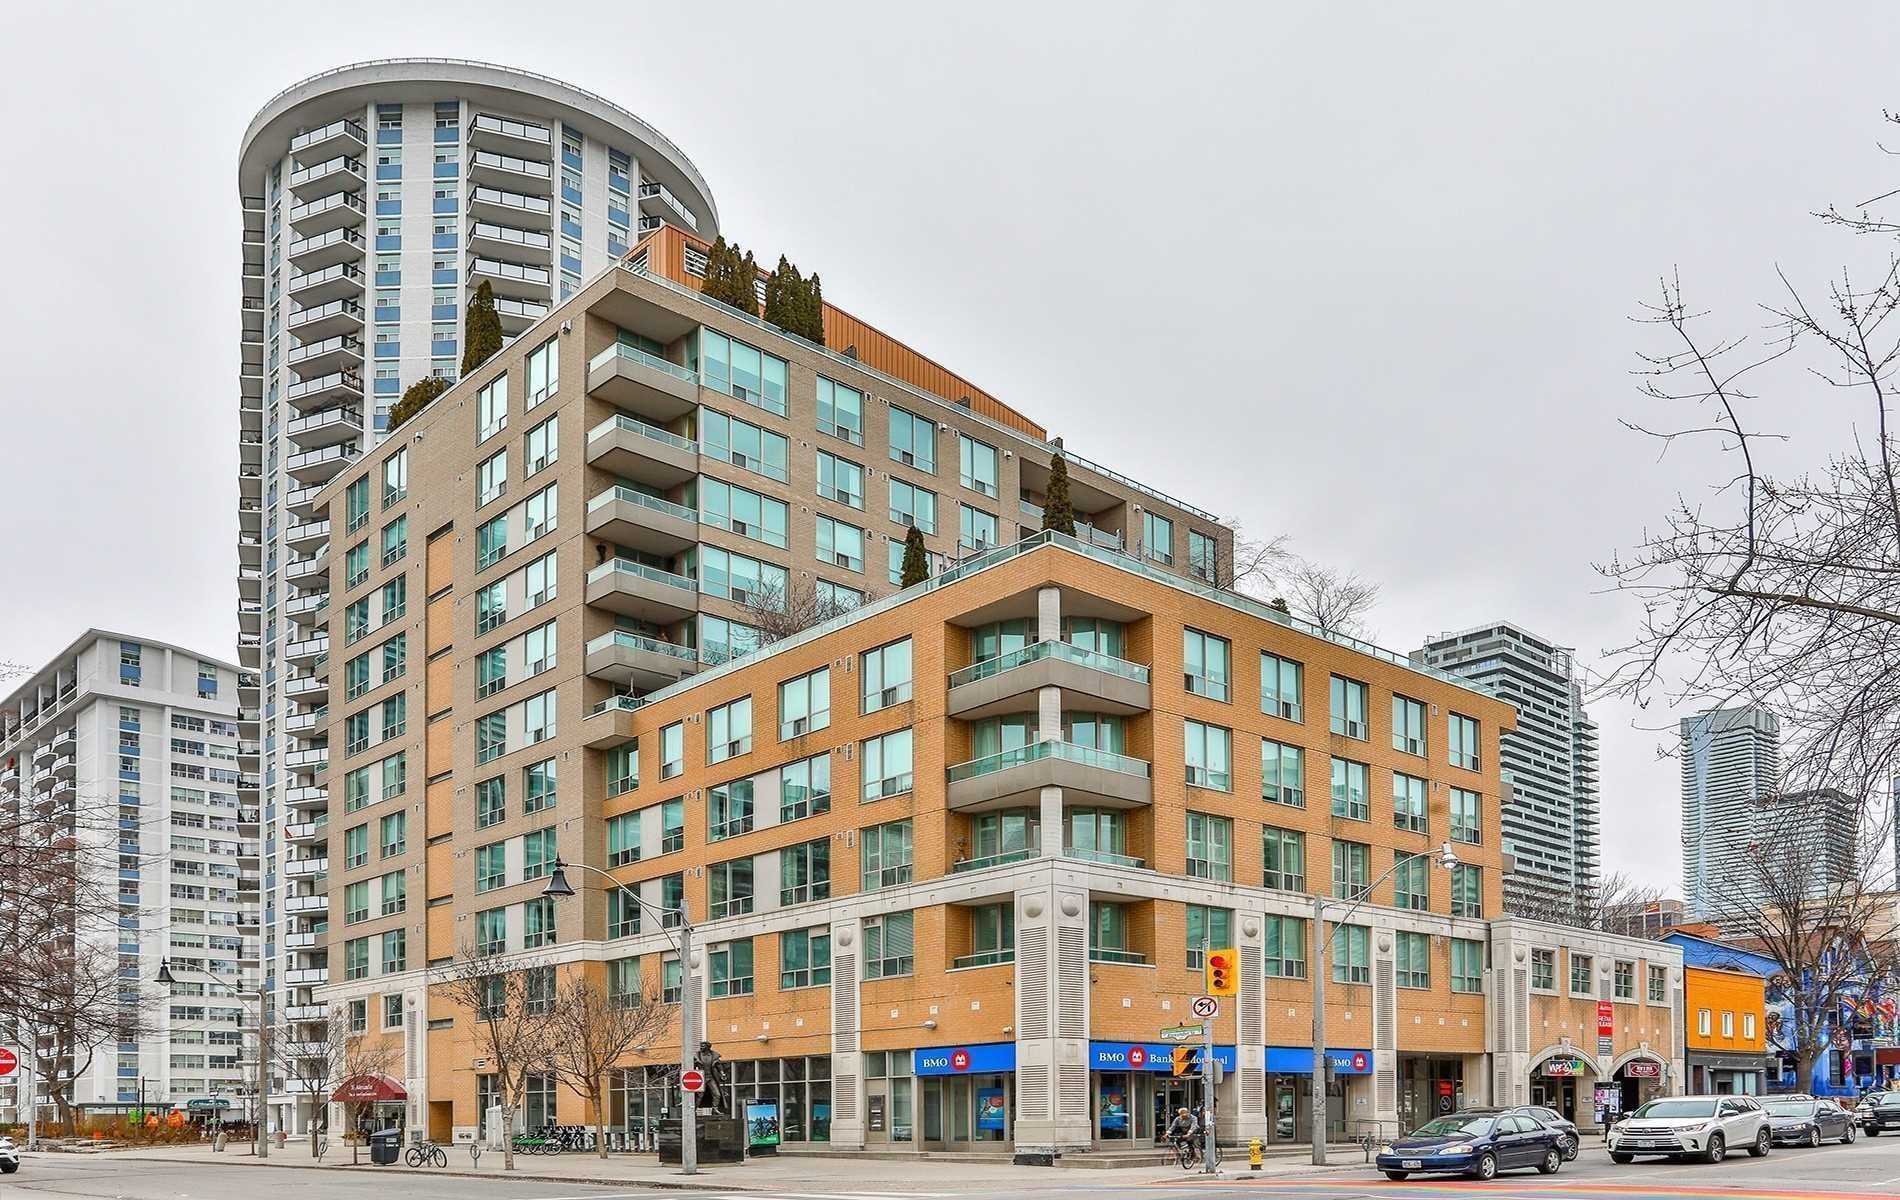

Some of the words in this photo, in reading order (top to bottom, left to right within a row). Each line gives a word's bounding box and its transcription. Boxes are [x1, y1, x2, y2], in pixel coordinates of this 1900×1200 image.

[923, 1057, 948, 1068] BMO
[1099, 1052, 1125, 1063] BMO
[1150, 1053, 1175, 1065] Bank
